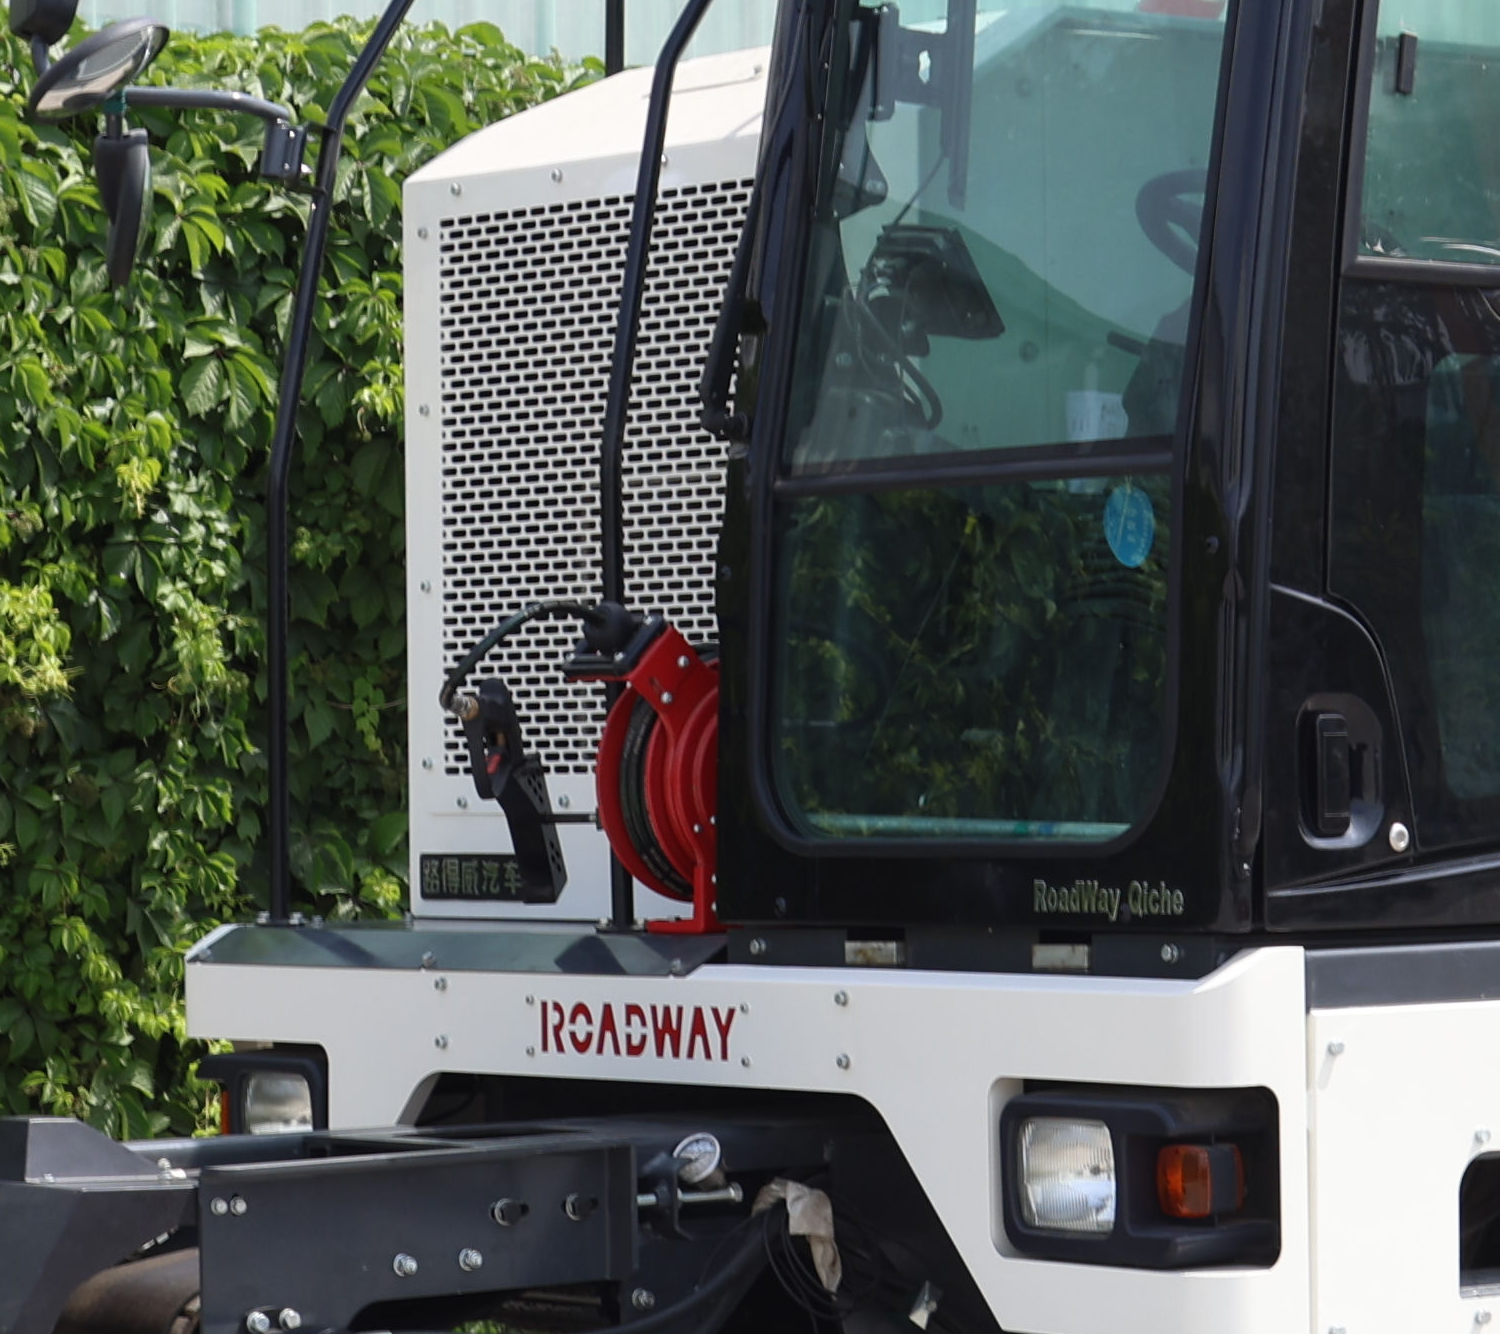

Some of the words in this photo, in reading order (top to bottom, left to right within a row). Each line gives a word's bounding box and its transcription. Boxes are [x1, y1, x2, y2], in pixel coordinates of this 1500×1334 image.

[422, 856, 523, 896] 路得威汽车
[1033, 878, 1121, 922] RoadWay
[1127, 879, 1185, 918] Qiche
[540, 1000, 736, 1061] ROADWAY
